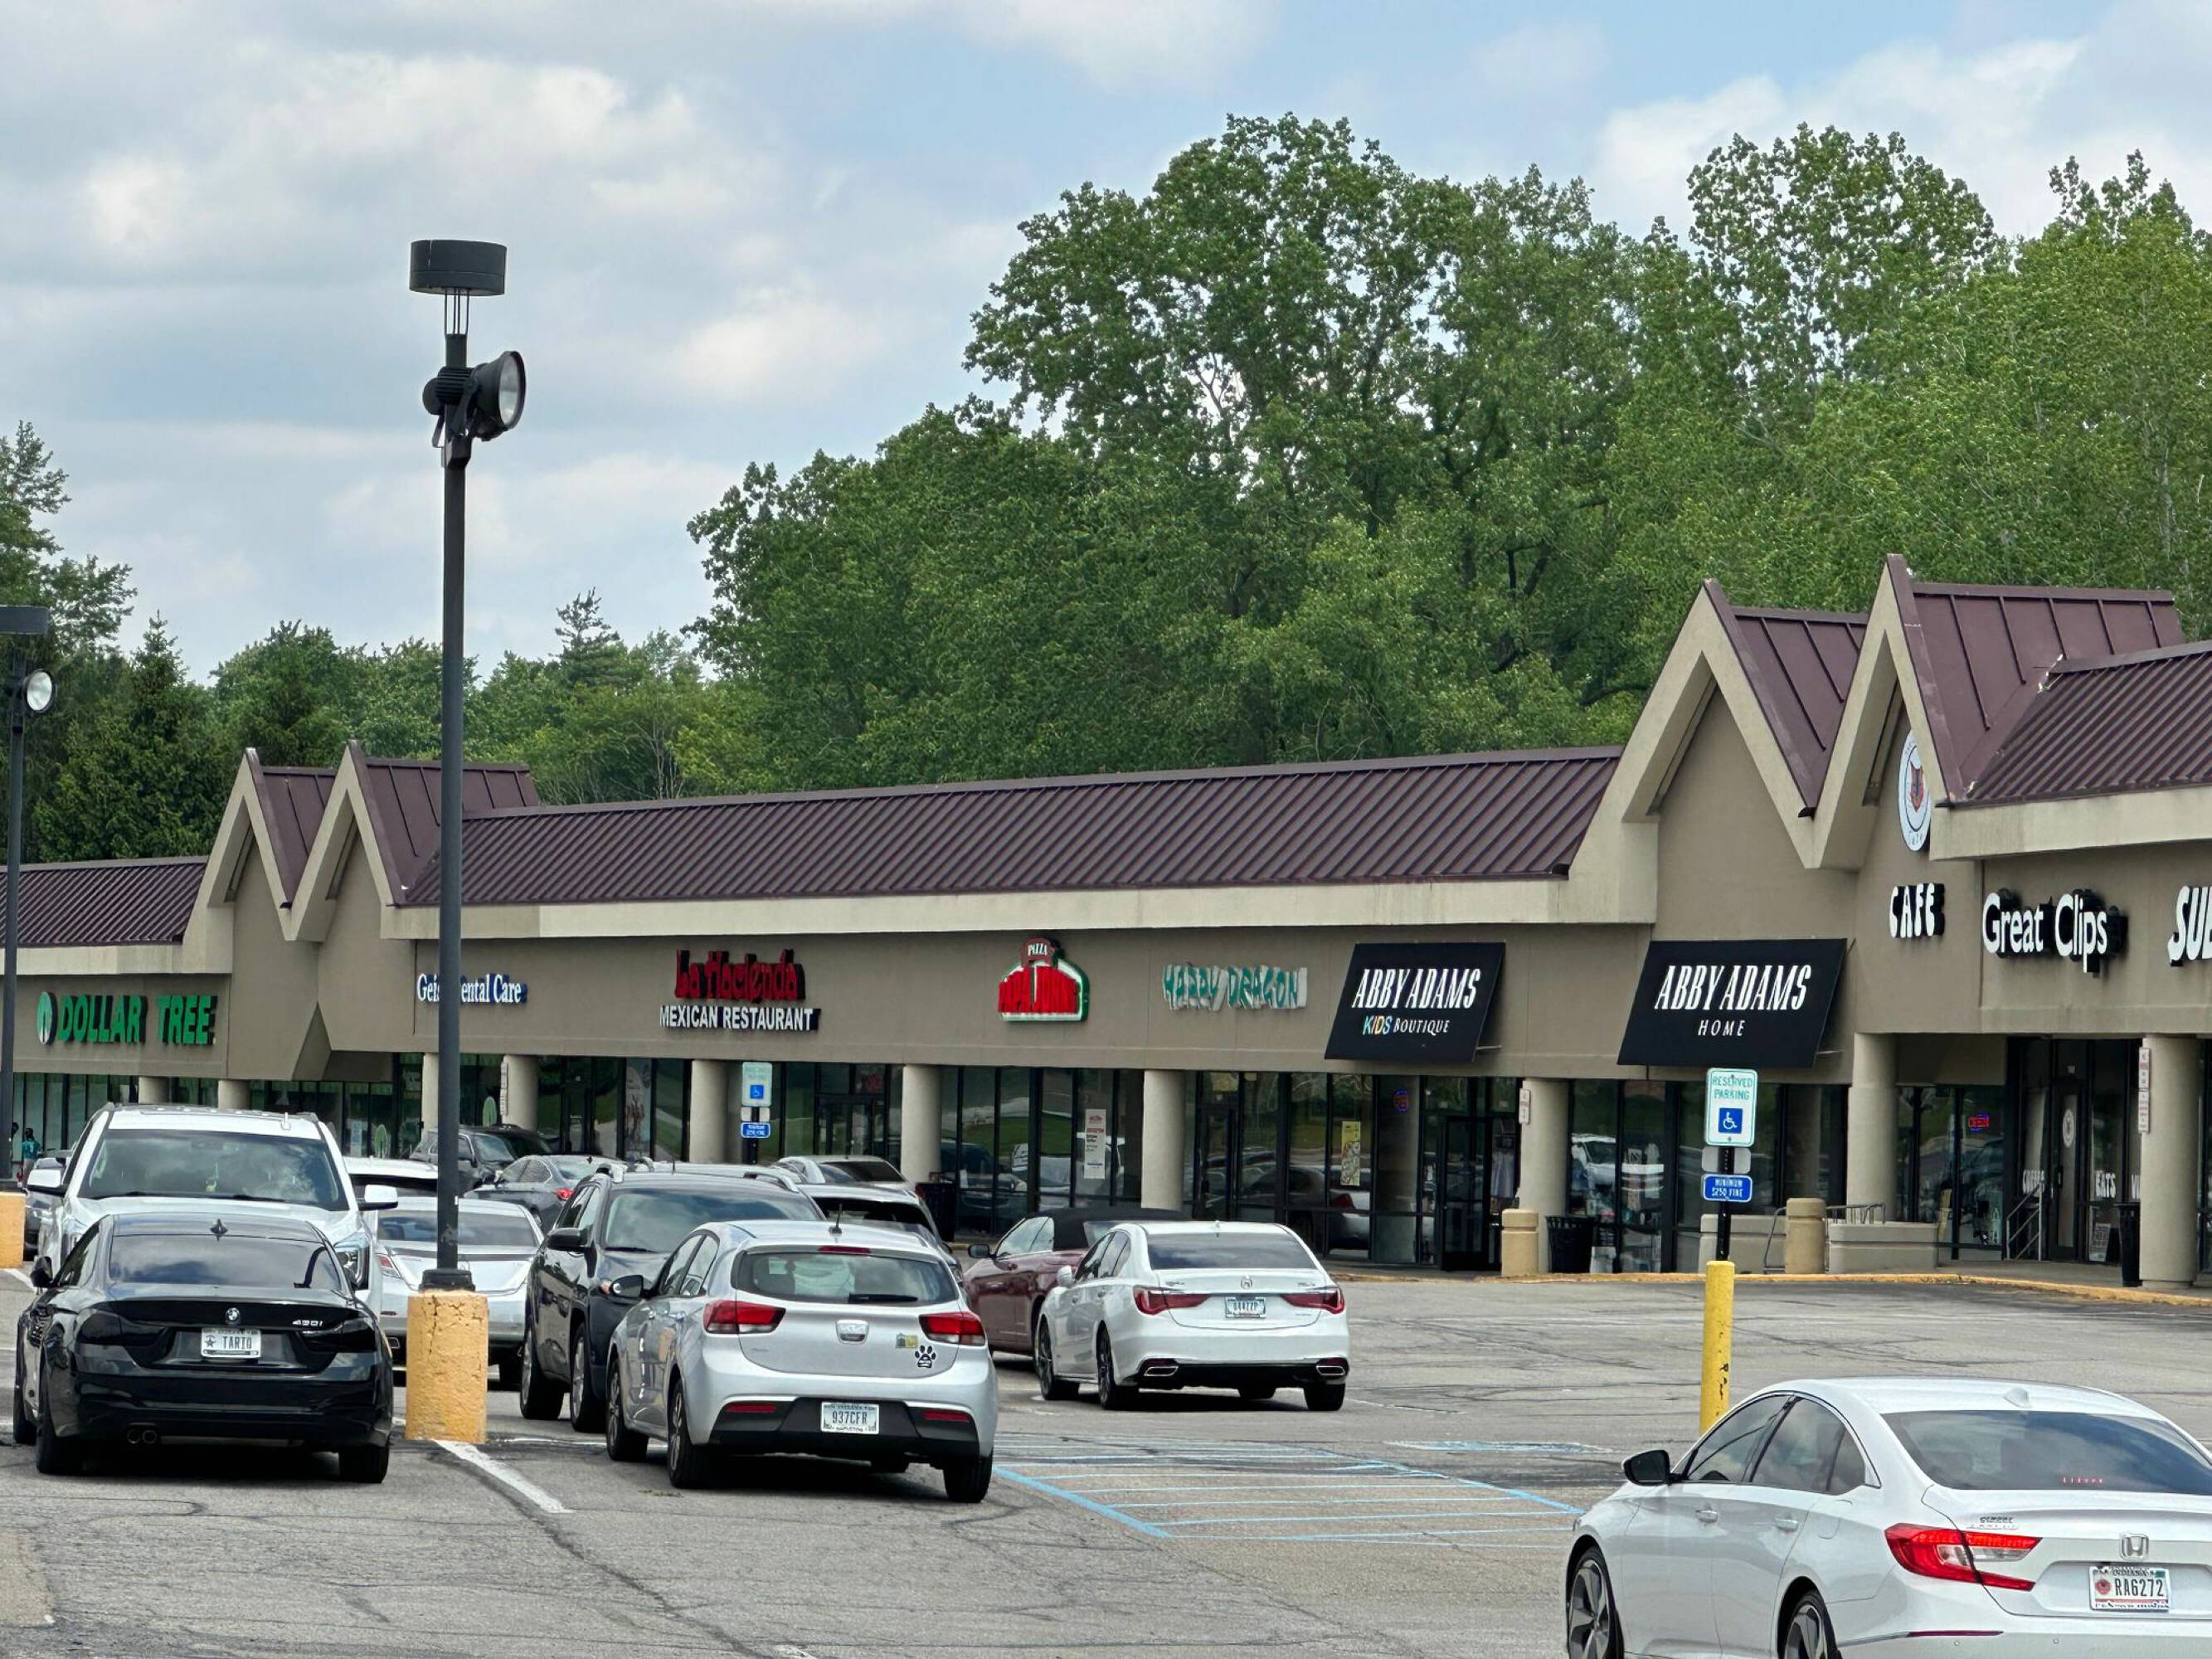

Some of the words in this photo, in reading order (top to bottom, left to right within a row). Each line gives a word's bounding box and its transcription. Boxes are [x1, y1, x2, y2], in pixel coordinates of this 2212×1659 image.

[1889, 882, 1936, 939] CAFE
[1983, 893, 2044, 953] Great
[2054, 893, 2107, 973] Clips
[459, 974, 490, 1003] ental
[493, 974, 523, 1003] Care
[1351, 968, 1410, 1009] ABBY
[1405, 967, 1481, 1010] ADAMS
[1655, 965, 1725, 1010] ABBY
[1719, 964, 1811, 1010] ADAMS
[57, 995, 143, 1044] DOLLAR
[158, 995, 212, 1044] TREE
[660, 1005, 718, 1029] MEXICAN
[722, 1006, 814, 1031] RESTAURANT
[1363, 1015, 1393, 1035] KIDS
[1393, 1018, 1451, 1036] BOUTIQUE
[1698, 1019, 1745, 1037] HOME
[1712, 1076, 1753, 1087] RESERVED
[1714, 1089, 1750, 1100] PARKING
[2114, 1578, 2164, 1598] RA6272
